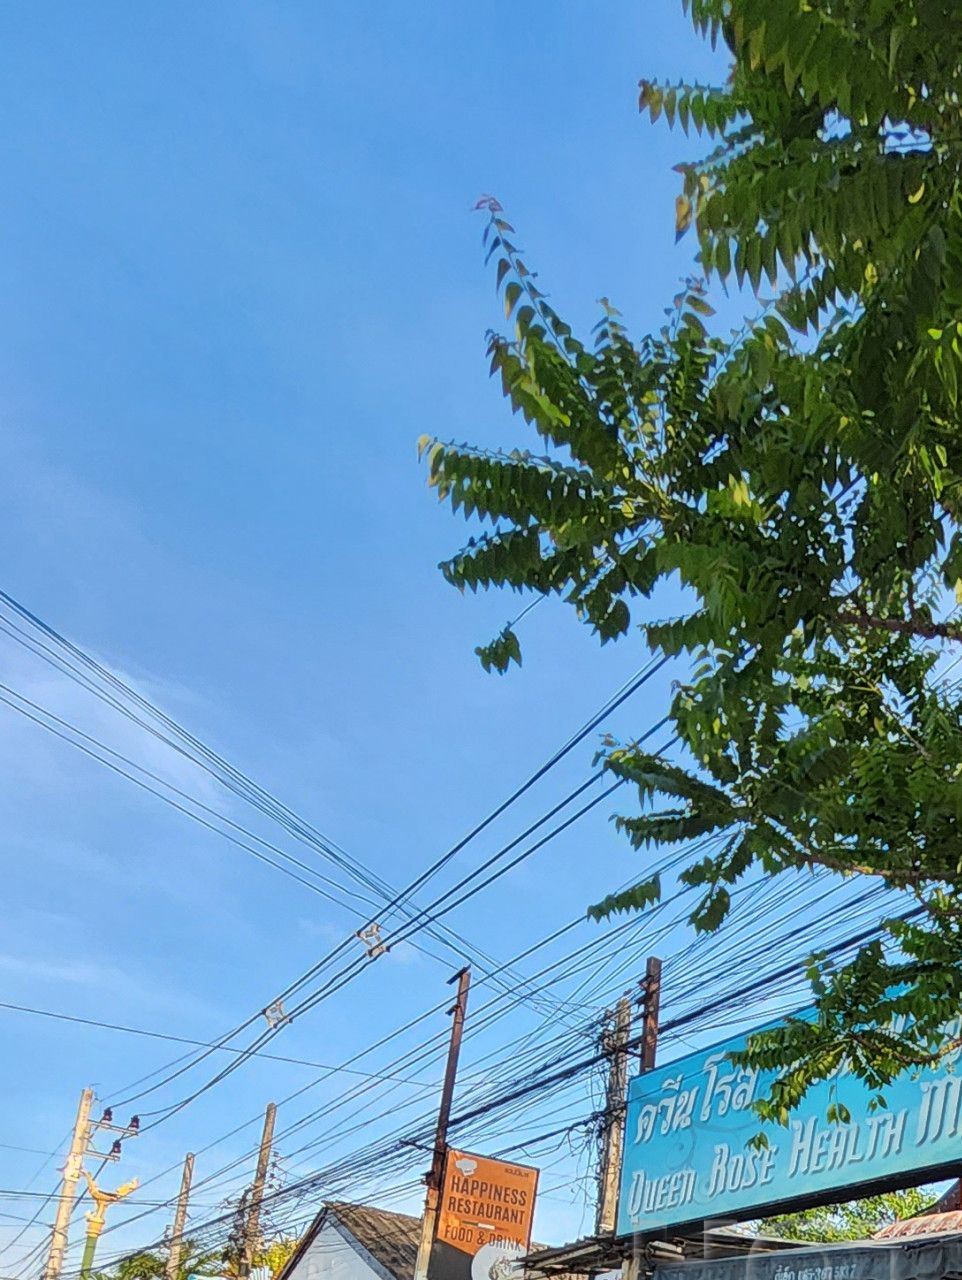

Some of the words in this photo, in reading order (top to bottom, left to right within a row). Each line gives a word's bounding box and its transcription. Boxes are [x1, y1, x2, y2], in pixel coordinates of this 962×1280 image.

[450, 1175, 528, 1207] HAPPINESS
[447, 1196, 526, 1225] RESTAURANT
[444, 1225, 473, 1243] FOOD
[476, 1231, 486, 1245] &
[488, 1233, 523, 1252] DRINK
